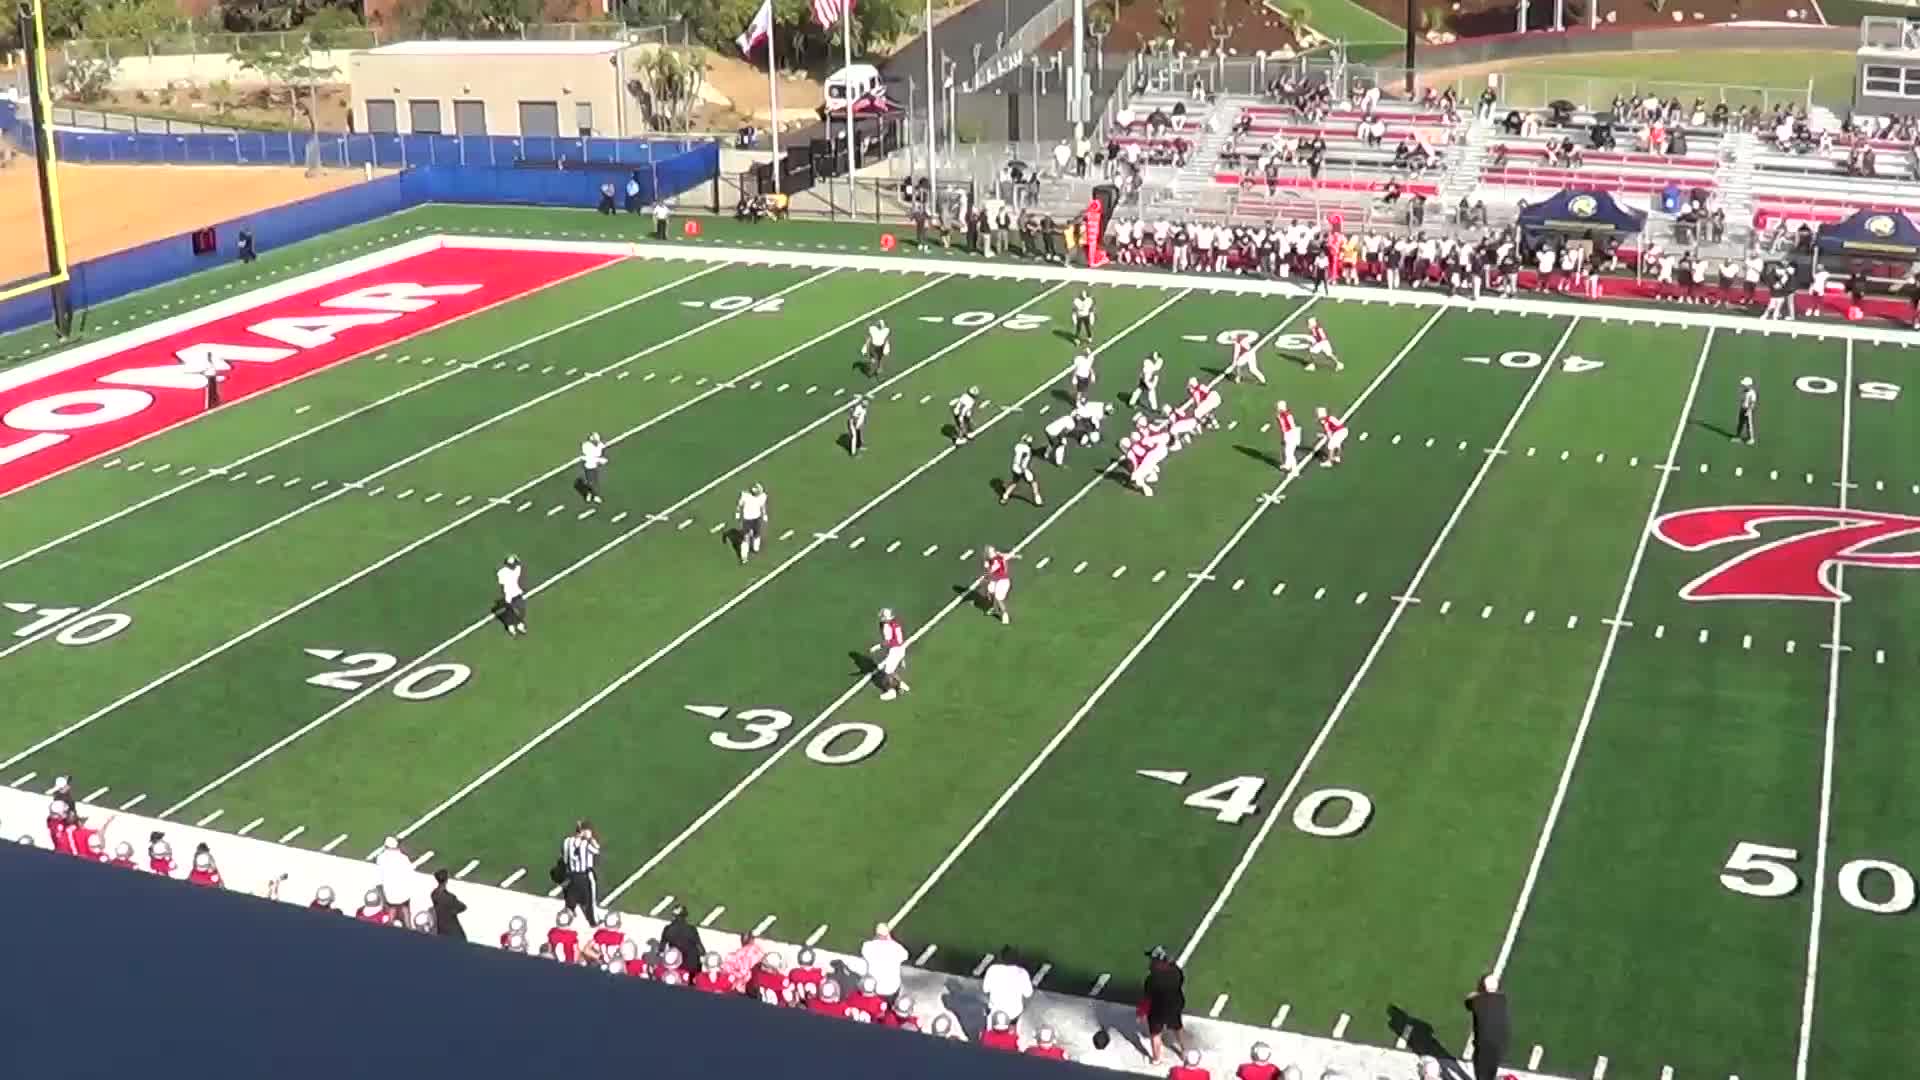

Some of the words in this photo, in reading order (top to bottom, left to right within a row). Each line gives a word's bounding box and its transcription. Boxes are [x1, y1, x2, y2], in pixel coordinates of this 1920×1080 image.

[952, 312, 1052, 330] 20
[1499, 351, 1604, 373] 40
[1796, 376, 1901, 400] 50
[13, 607, 131, 646] 10
[305, 652, 471, 699] 20
[709, 709, 886, 764] 30
[1184, 775, 1374, 837] 40
[1720, 842, 1917, 914] 50
